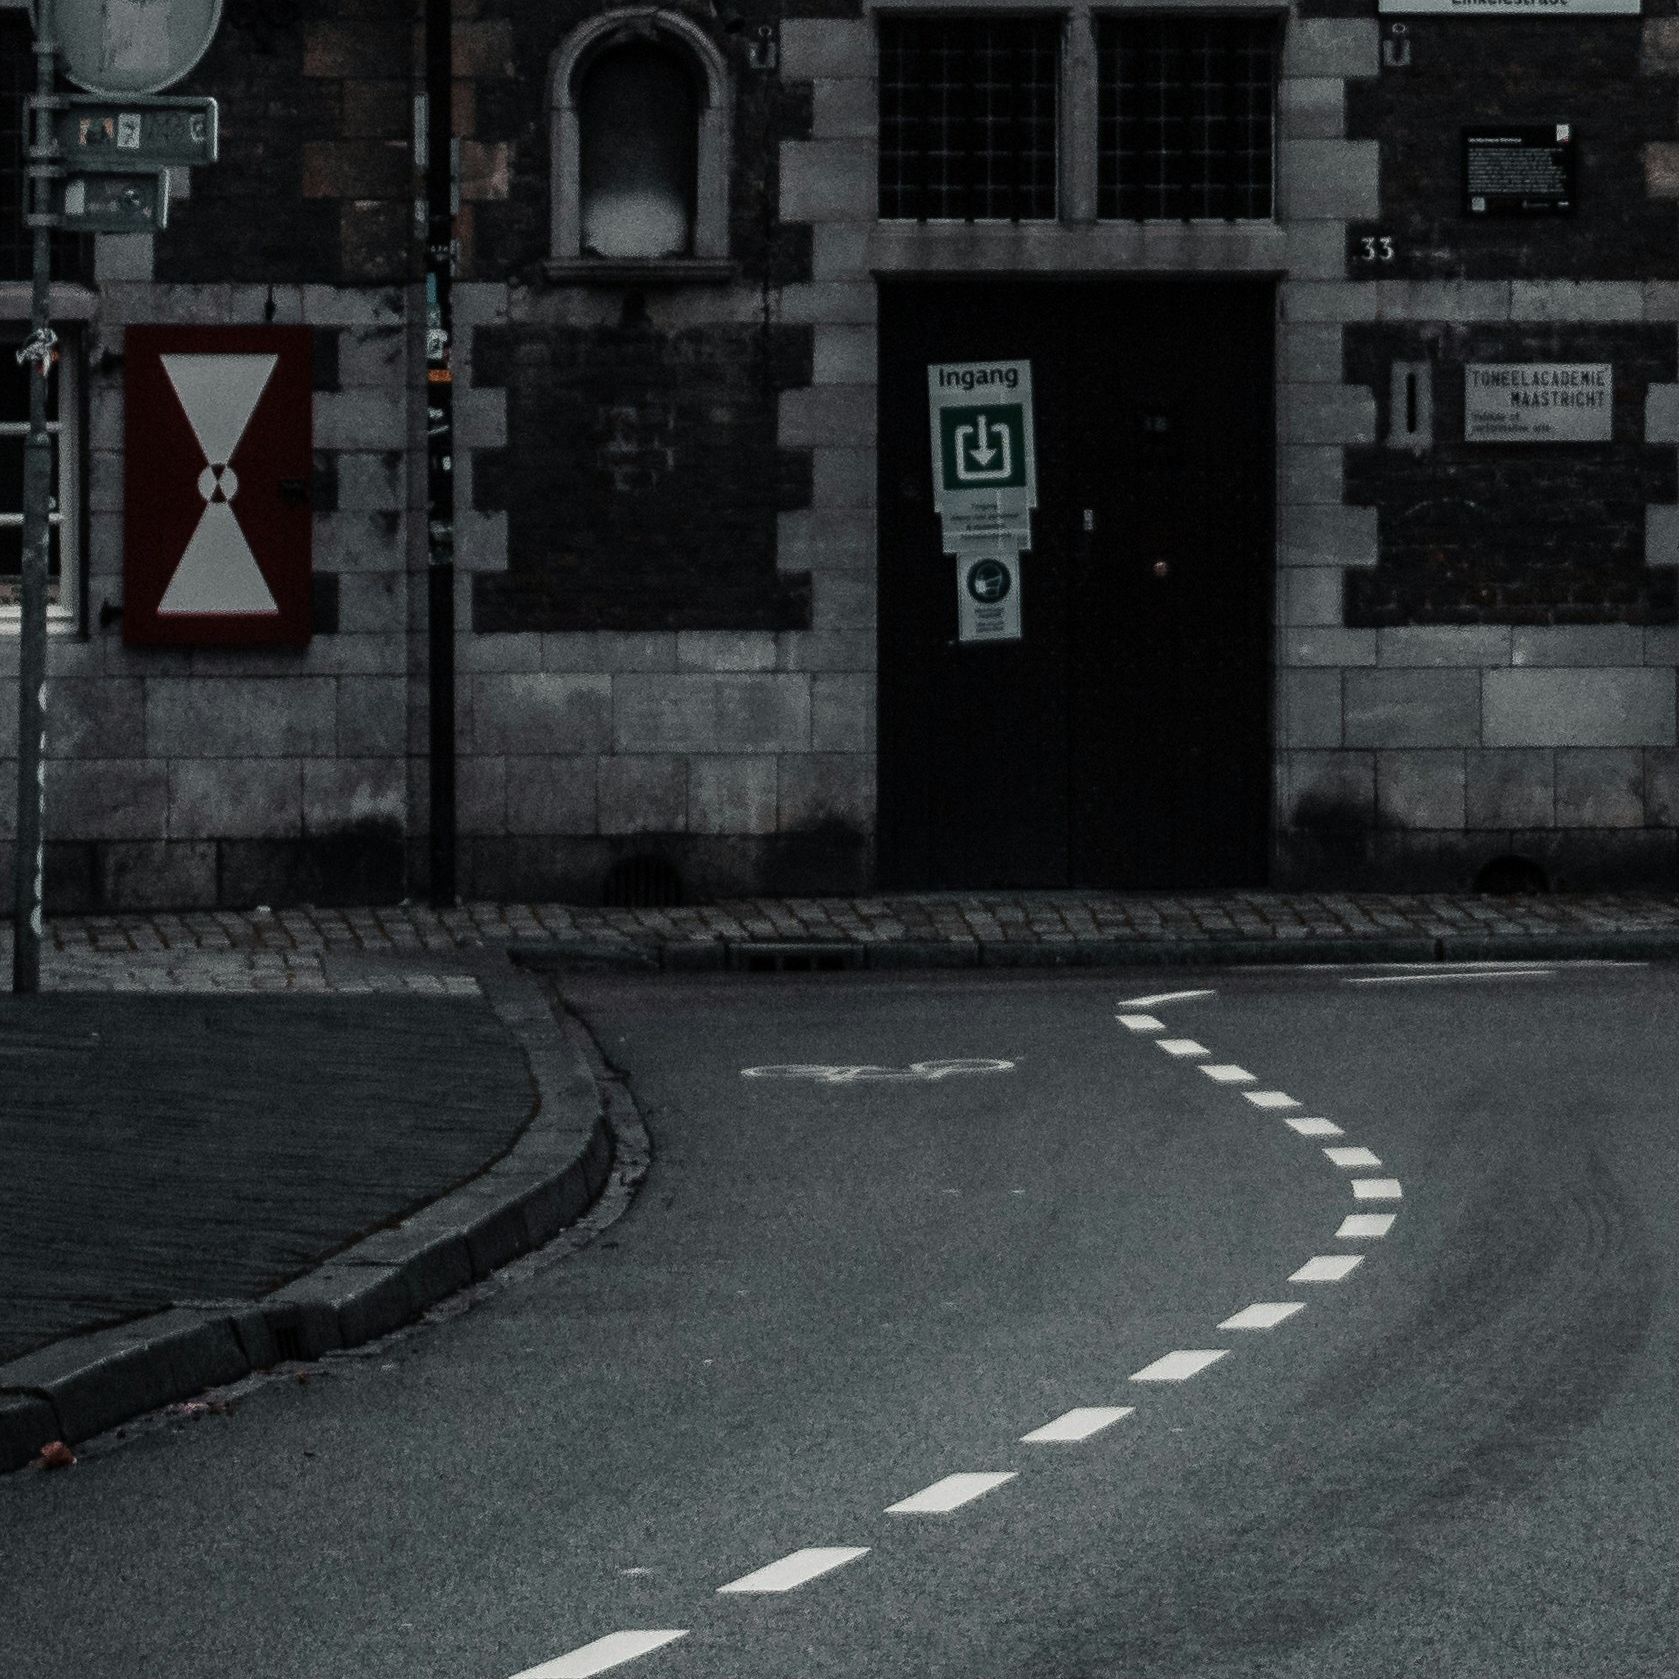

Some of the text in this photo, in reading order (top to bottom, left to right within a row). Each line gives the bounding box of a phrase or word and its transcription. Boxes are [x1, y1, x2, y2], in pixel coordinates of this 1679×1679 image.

[1360, 235, 1395, 261] 33
[938, 367, 1019, 391] Ingang
[1472, 370, 1606, 387] TONEELACADEMIE
[1510, 390, 1604, 407] MAASTRICHT
